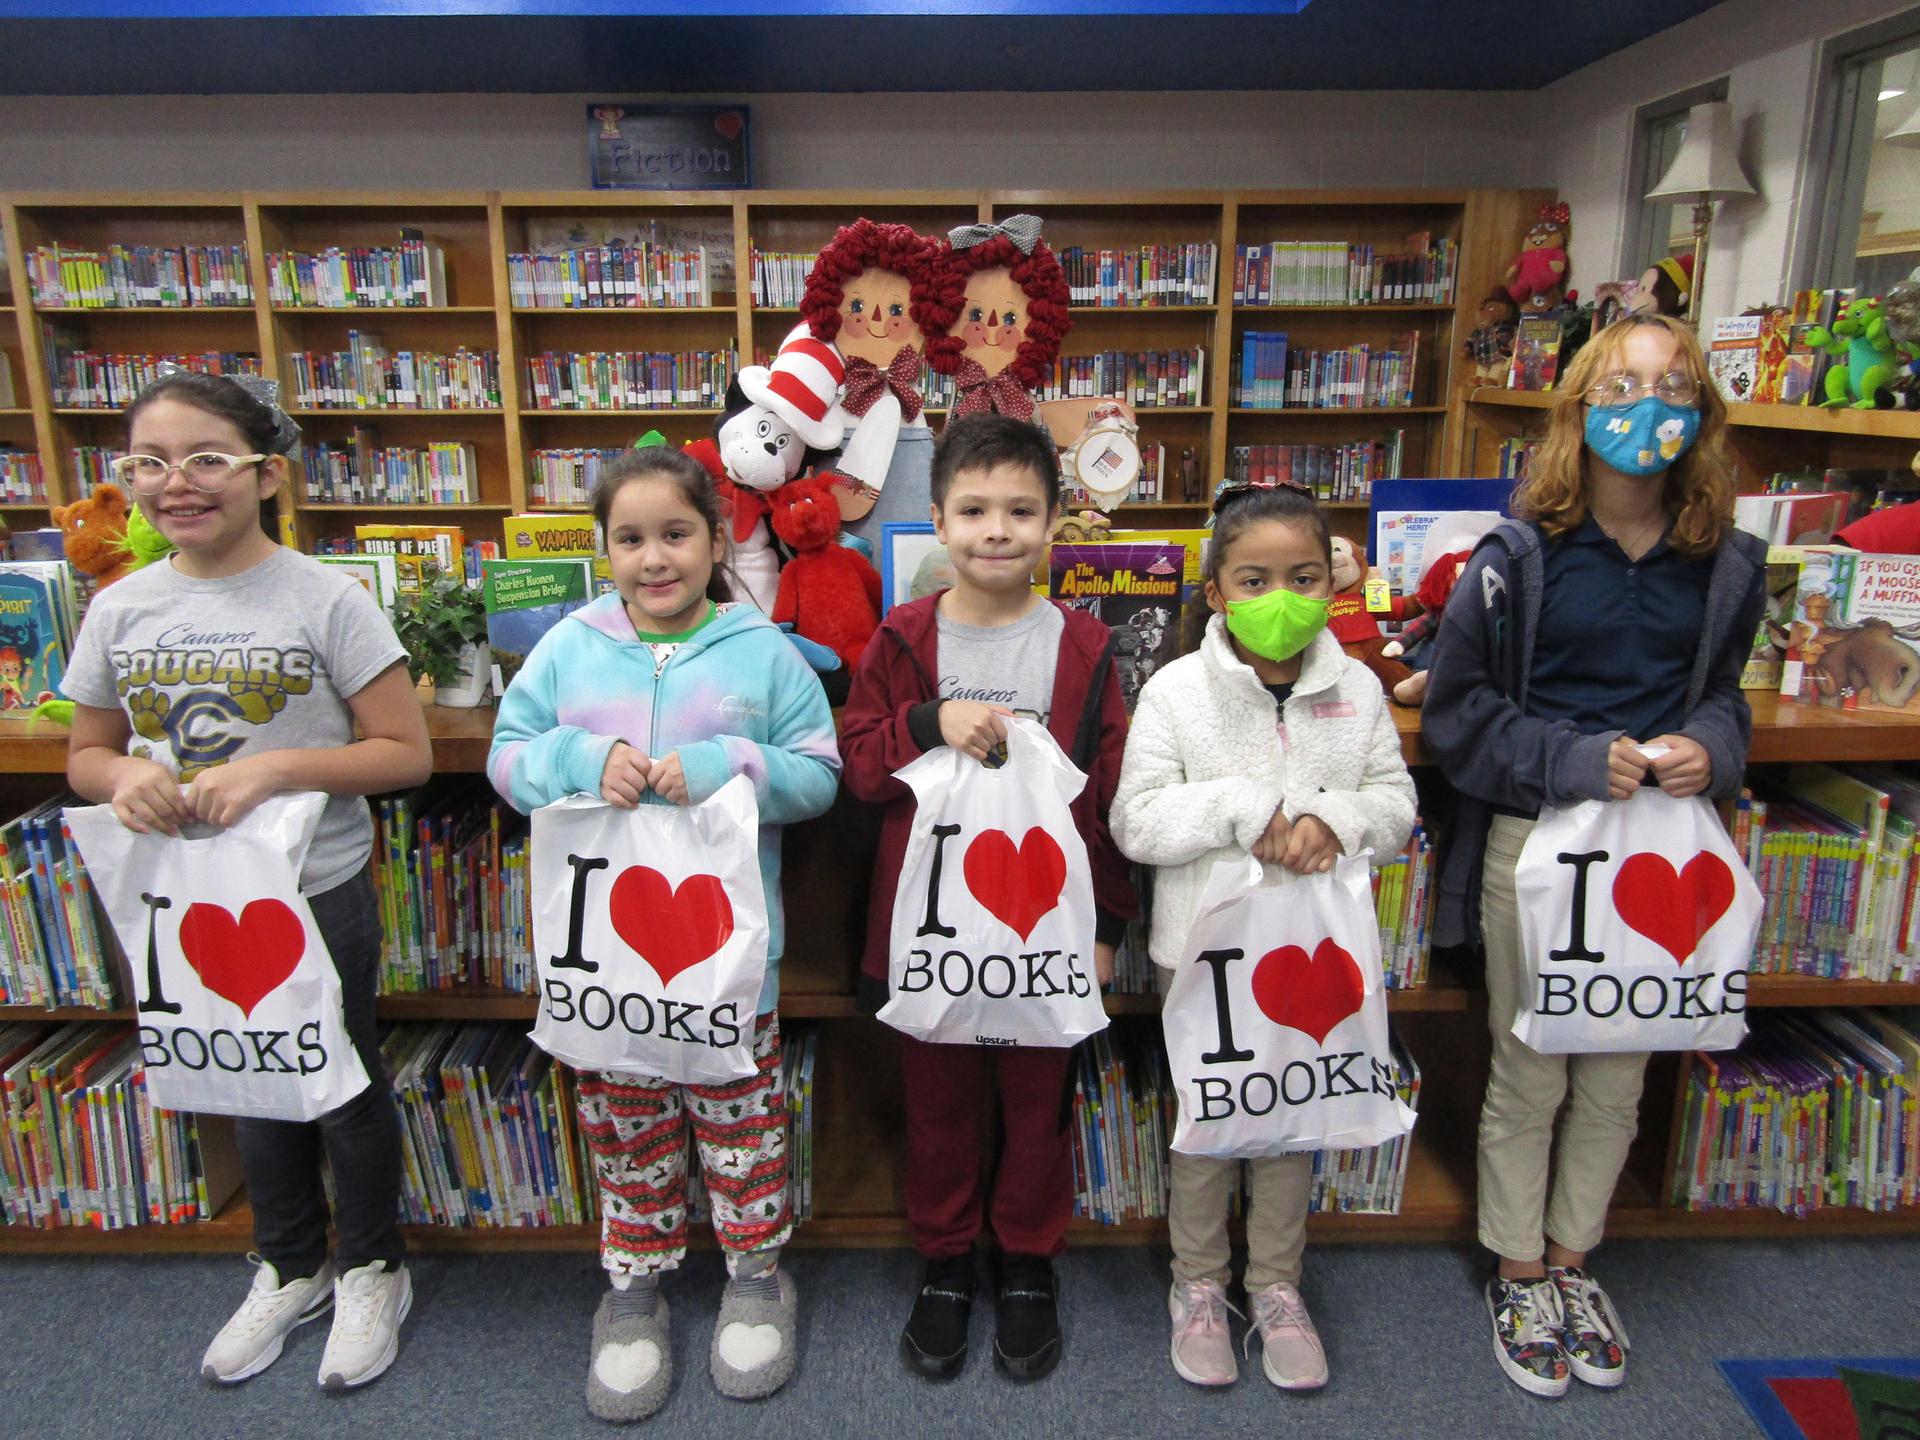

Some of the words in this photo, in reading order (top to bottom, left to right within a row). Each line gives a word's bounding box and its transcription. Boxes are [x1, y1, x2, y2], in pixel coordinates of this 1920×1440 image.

[609, 143, 730, 173] Fiction
[365, 540, 396, 554] BIRDS
[400, 540, 413, 554] OF
[417, 540, 437, 554] PRE
[1060, 569, 1110, 597] Apollo
[1110, 570, 1177, 595] Missions
[1076, 563, 1095, 577] The
[1860, 560, 1874, 572] IF
[1877, 561, 1900, 573] YOU
[1904, 562, 1920, 576] GI
[1864, 576, 1873, 586] A
[1878, 576, 1920, 589] MOOSE
[495, 578, 526, 591] Charles
[496, 588, 541, 604] Suspension
[542, 583, 567, 597] Bridge
[1859, 589, 1868, 599] A
[156, 622, 256, 648] Cavazos
[112, 648, 315, 695] COUGARS
[938, 675, 1018, 702] Cavazos
[916, 823, 961, 938] I
[550, 853, 609, 973] I
[1549, 850, 1609, 963] I
[138, 892, 182, 1015] I
[898, 949, 1091, 998] BOOKS
[1194, 948, 1255, 1065] I
[1535, 969, 1749, 1019] BOOKS
[545, 978, 740, 1049] BOOKS
[138, 1020, 328, 1075] BOOKS
[976, 1035, 1017, 1046] Upstart
[1192, 1051, 1396, 1122] BOOKS
